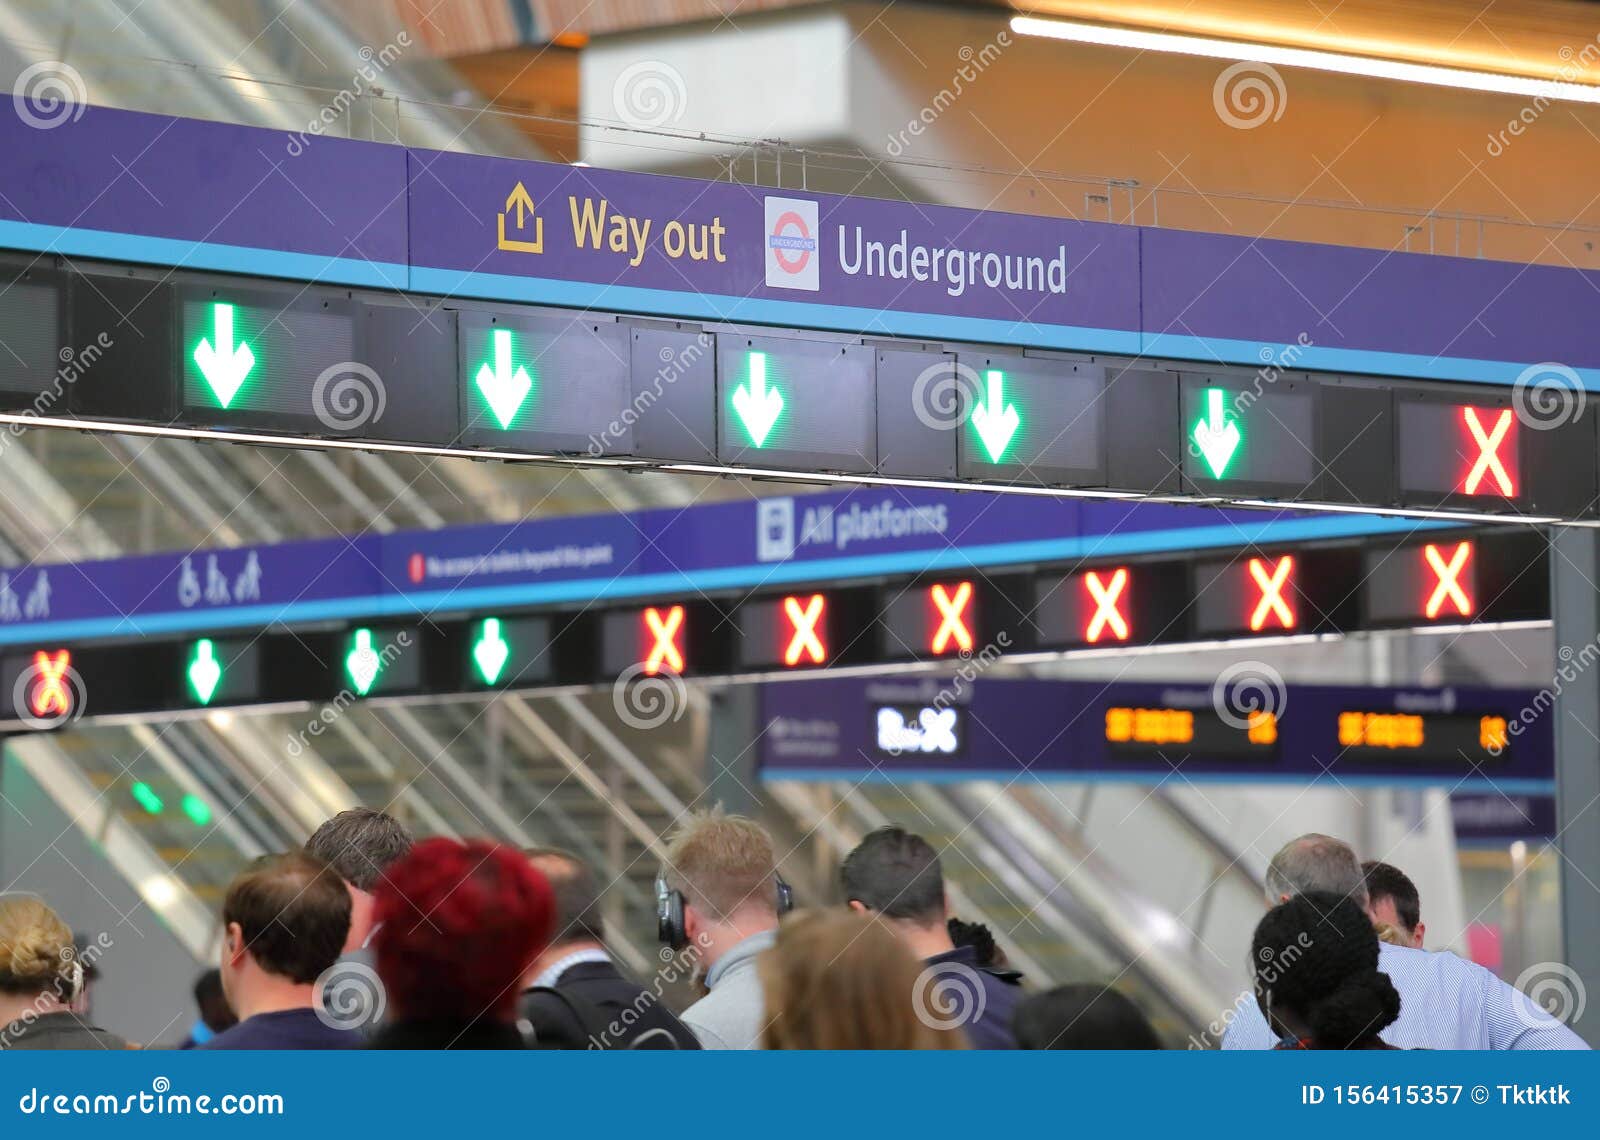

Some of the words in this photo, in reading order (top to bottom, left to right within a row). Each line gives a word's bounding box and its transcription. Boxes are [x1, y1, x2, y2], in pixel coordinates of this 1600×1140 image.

[569, 195, 652, 267] Way
[663, 216, 727, 263] out
[838, 224, 1067, 297] Underground
[801, 504, 834, 545] All
[836, 500, 949, 550] platforms
